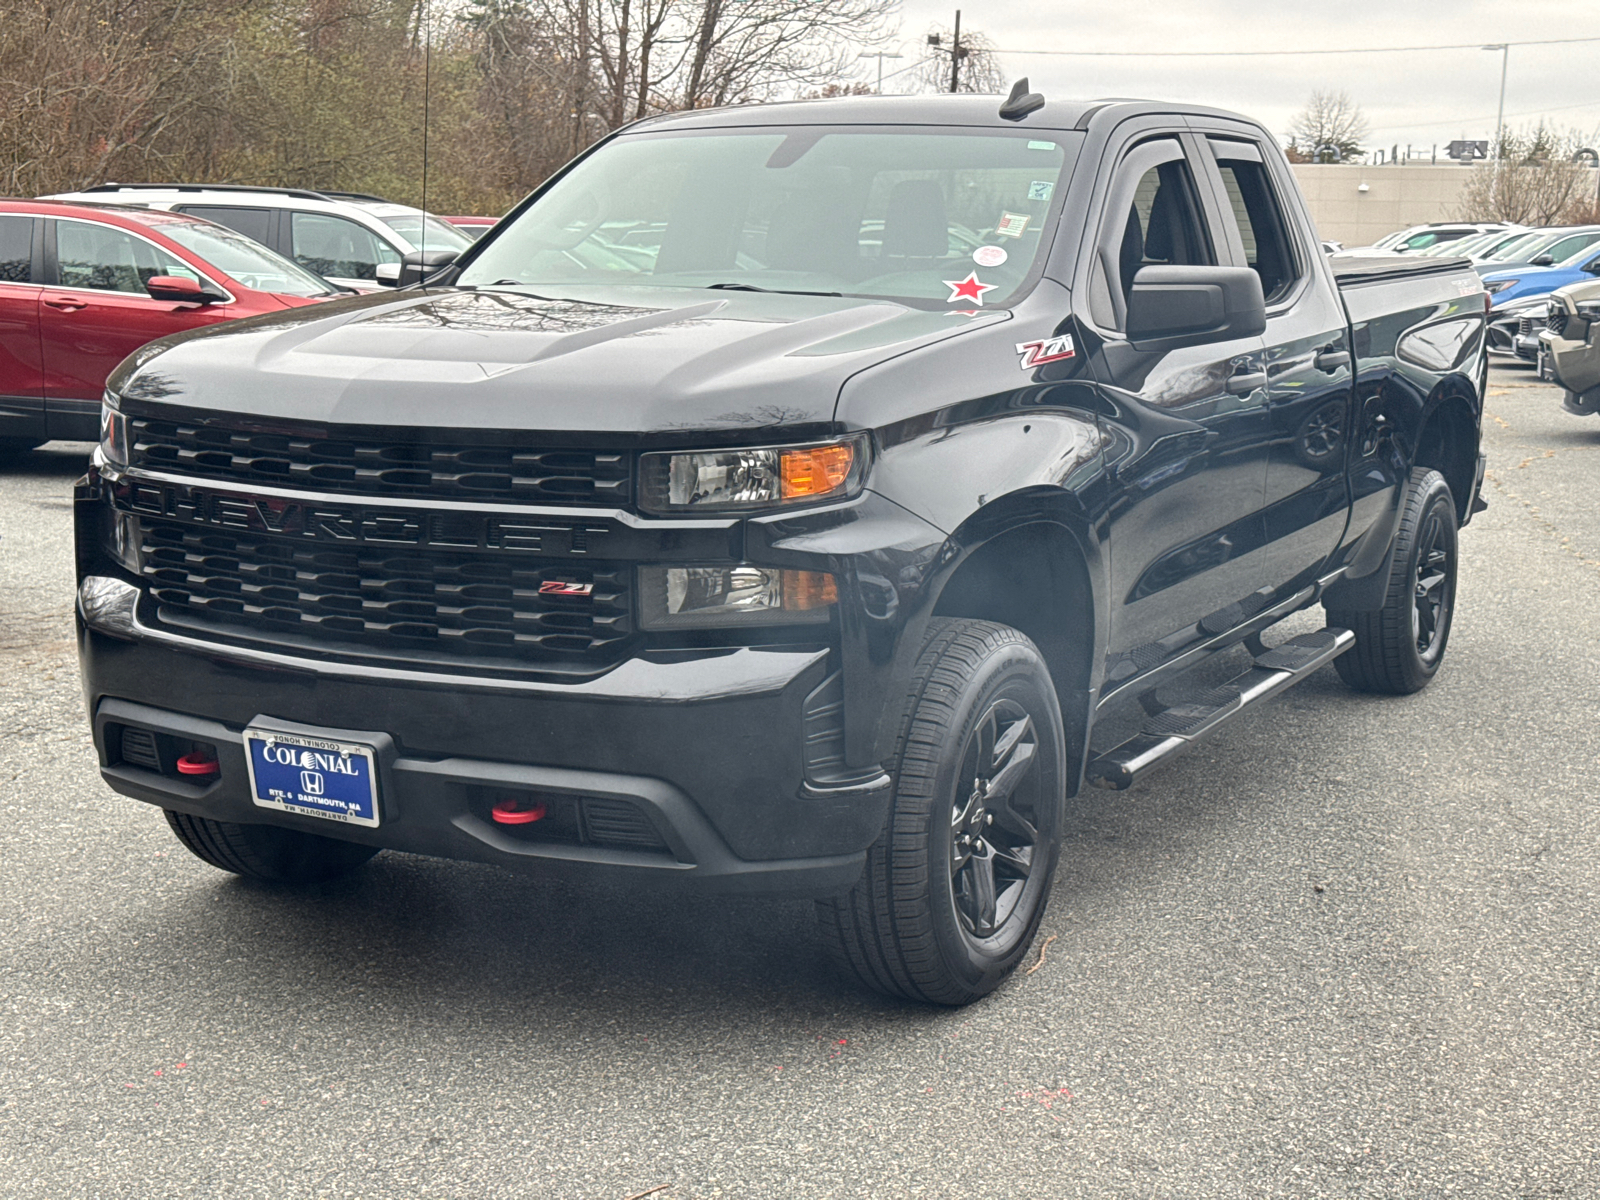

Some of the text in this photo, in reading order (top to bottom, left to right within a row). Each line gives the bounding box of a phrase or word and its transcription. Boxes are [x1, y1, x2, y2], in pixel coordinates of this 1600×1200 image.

[1015, 333, 1075, 370] Z71
[129, 483, 609, 553] CHEVROLET
[538, 581, 593, 595] Z71
[263, 745, 359, 776] COLONIAL
[269, 789, 287, 798] RTE.
[349, 802, 361, 811] MA
